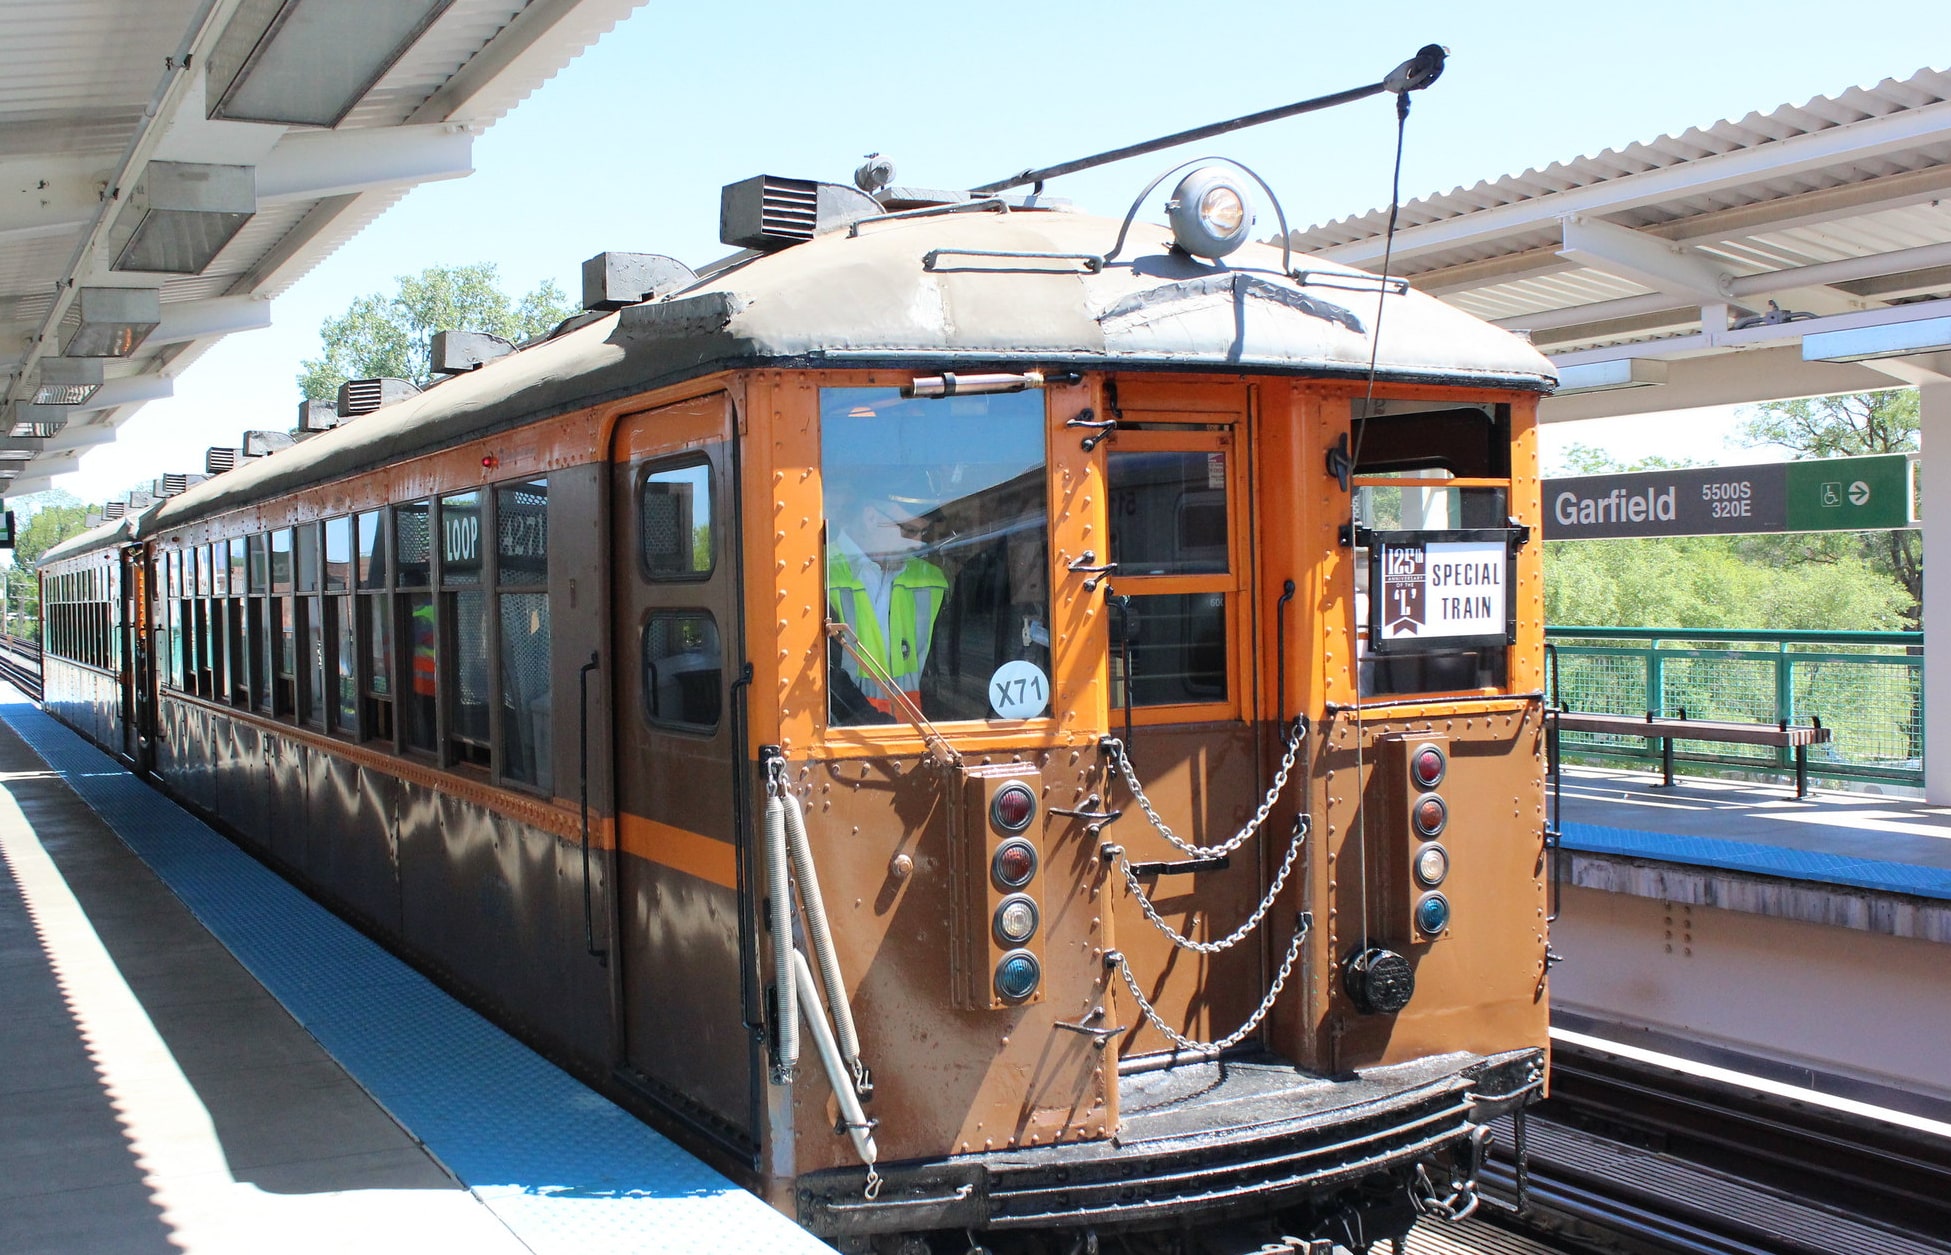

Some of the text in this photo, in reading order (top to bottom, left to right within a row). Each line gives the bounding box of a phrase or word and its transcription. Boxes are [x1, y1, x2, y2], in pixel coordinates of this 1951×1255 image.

[1702, 481, 1751, 501] 5500S
[1555, 486, 1677, 526] Garfield
[1712, 500, 1751, 518] 320E
[446, 516, 478, 561] LOOP
[1432, 563, 1501, 587] SPECIAL
[1442, 596, 1492, 620] TRAIN
[995, 675, 1042, 708] X71
